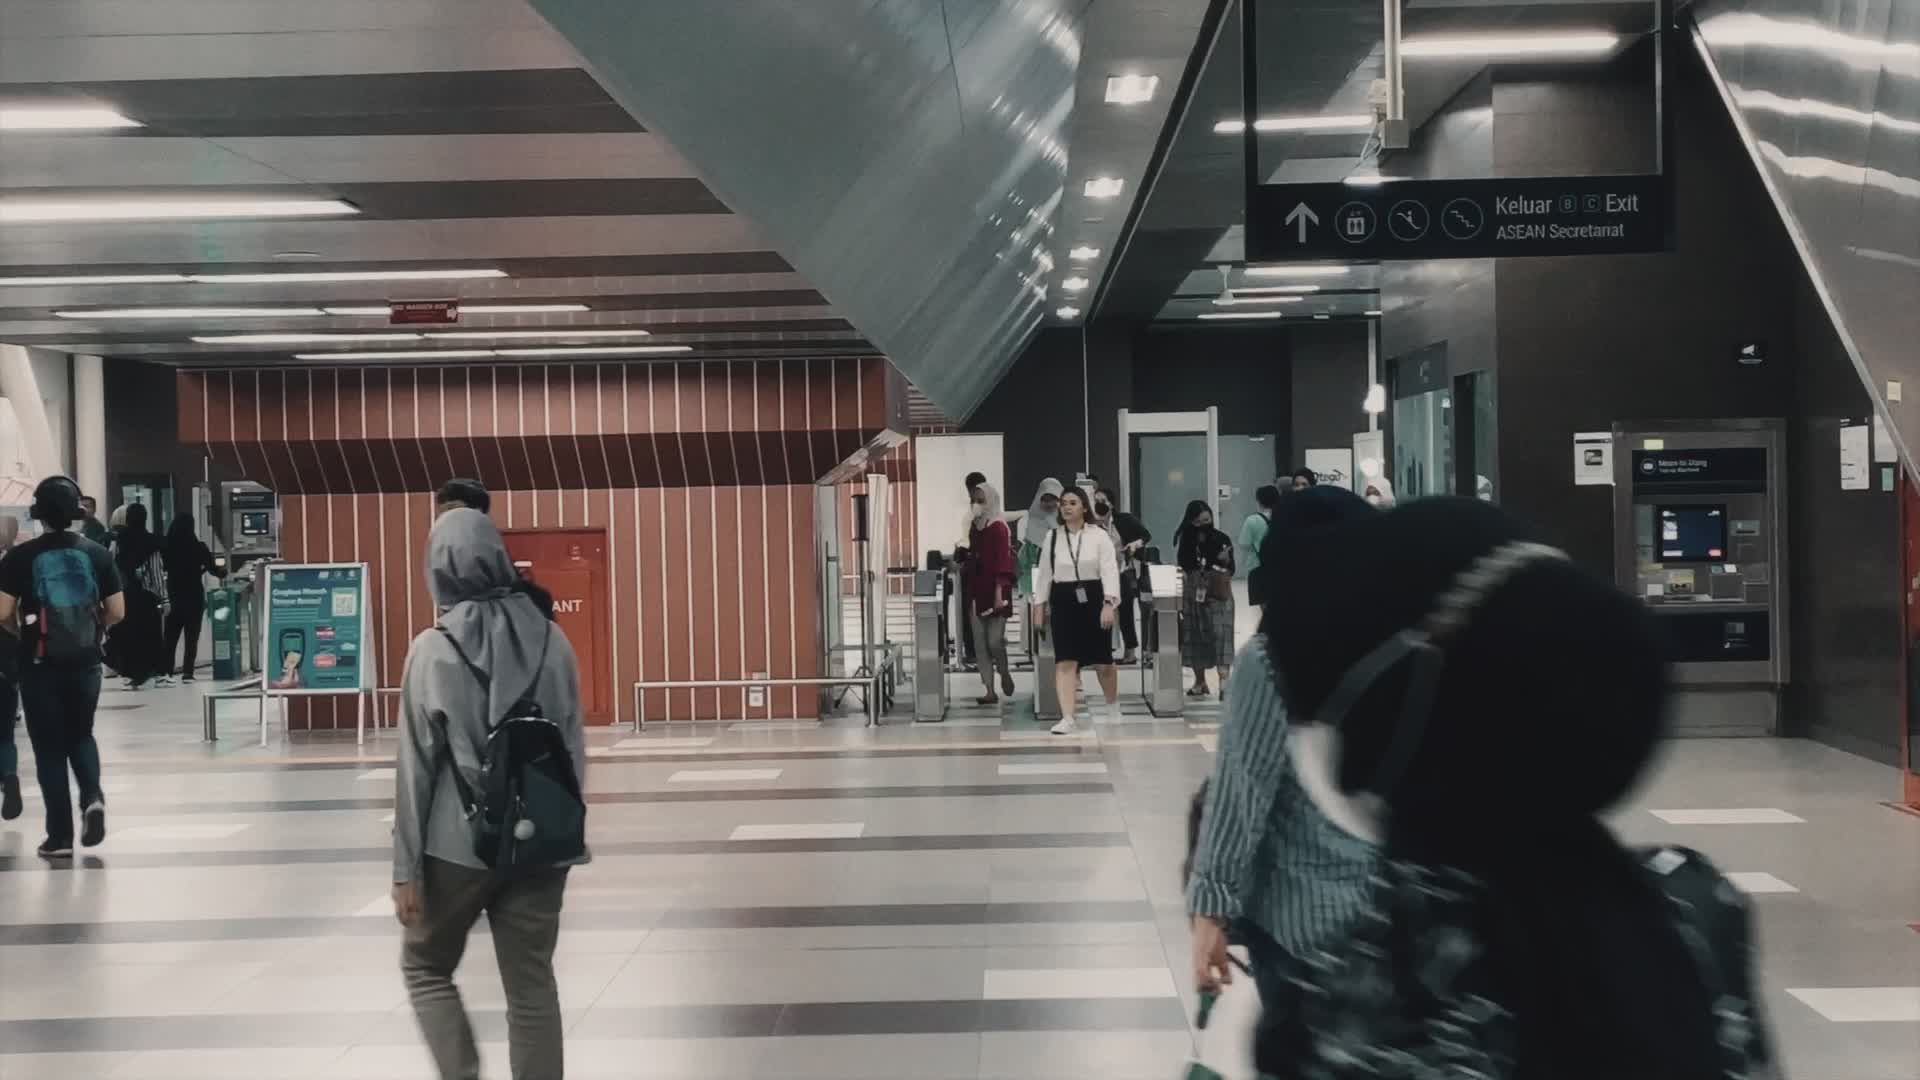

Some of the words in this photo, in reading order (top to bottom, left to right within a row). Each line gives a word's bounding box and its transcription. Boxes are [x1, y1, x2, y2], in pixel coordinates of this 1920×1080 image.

[1496, 195, 1552, 215] Keluar
[1606, 193, 1639, 212] Exit
[1496, 224, 1545, 240] ASEAN
[552, 599, 583, 612] ANT
